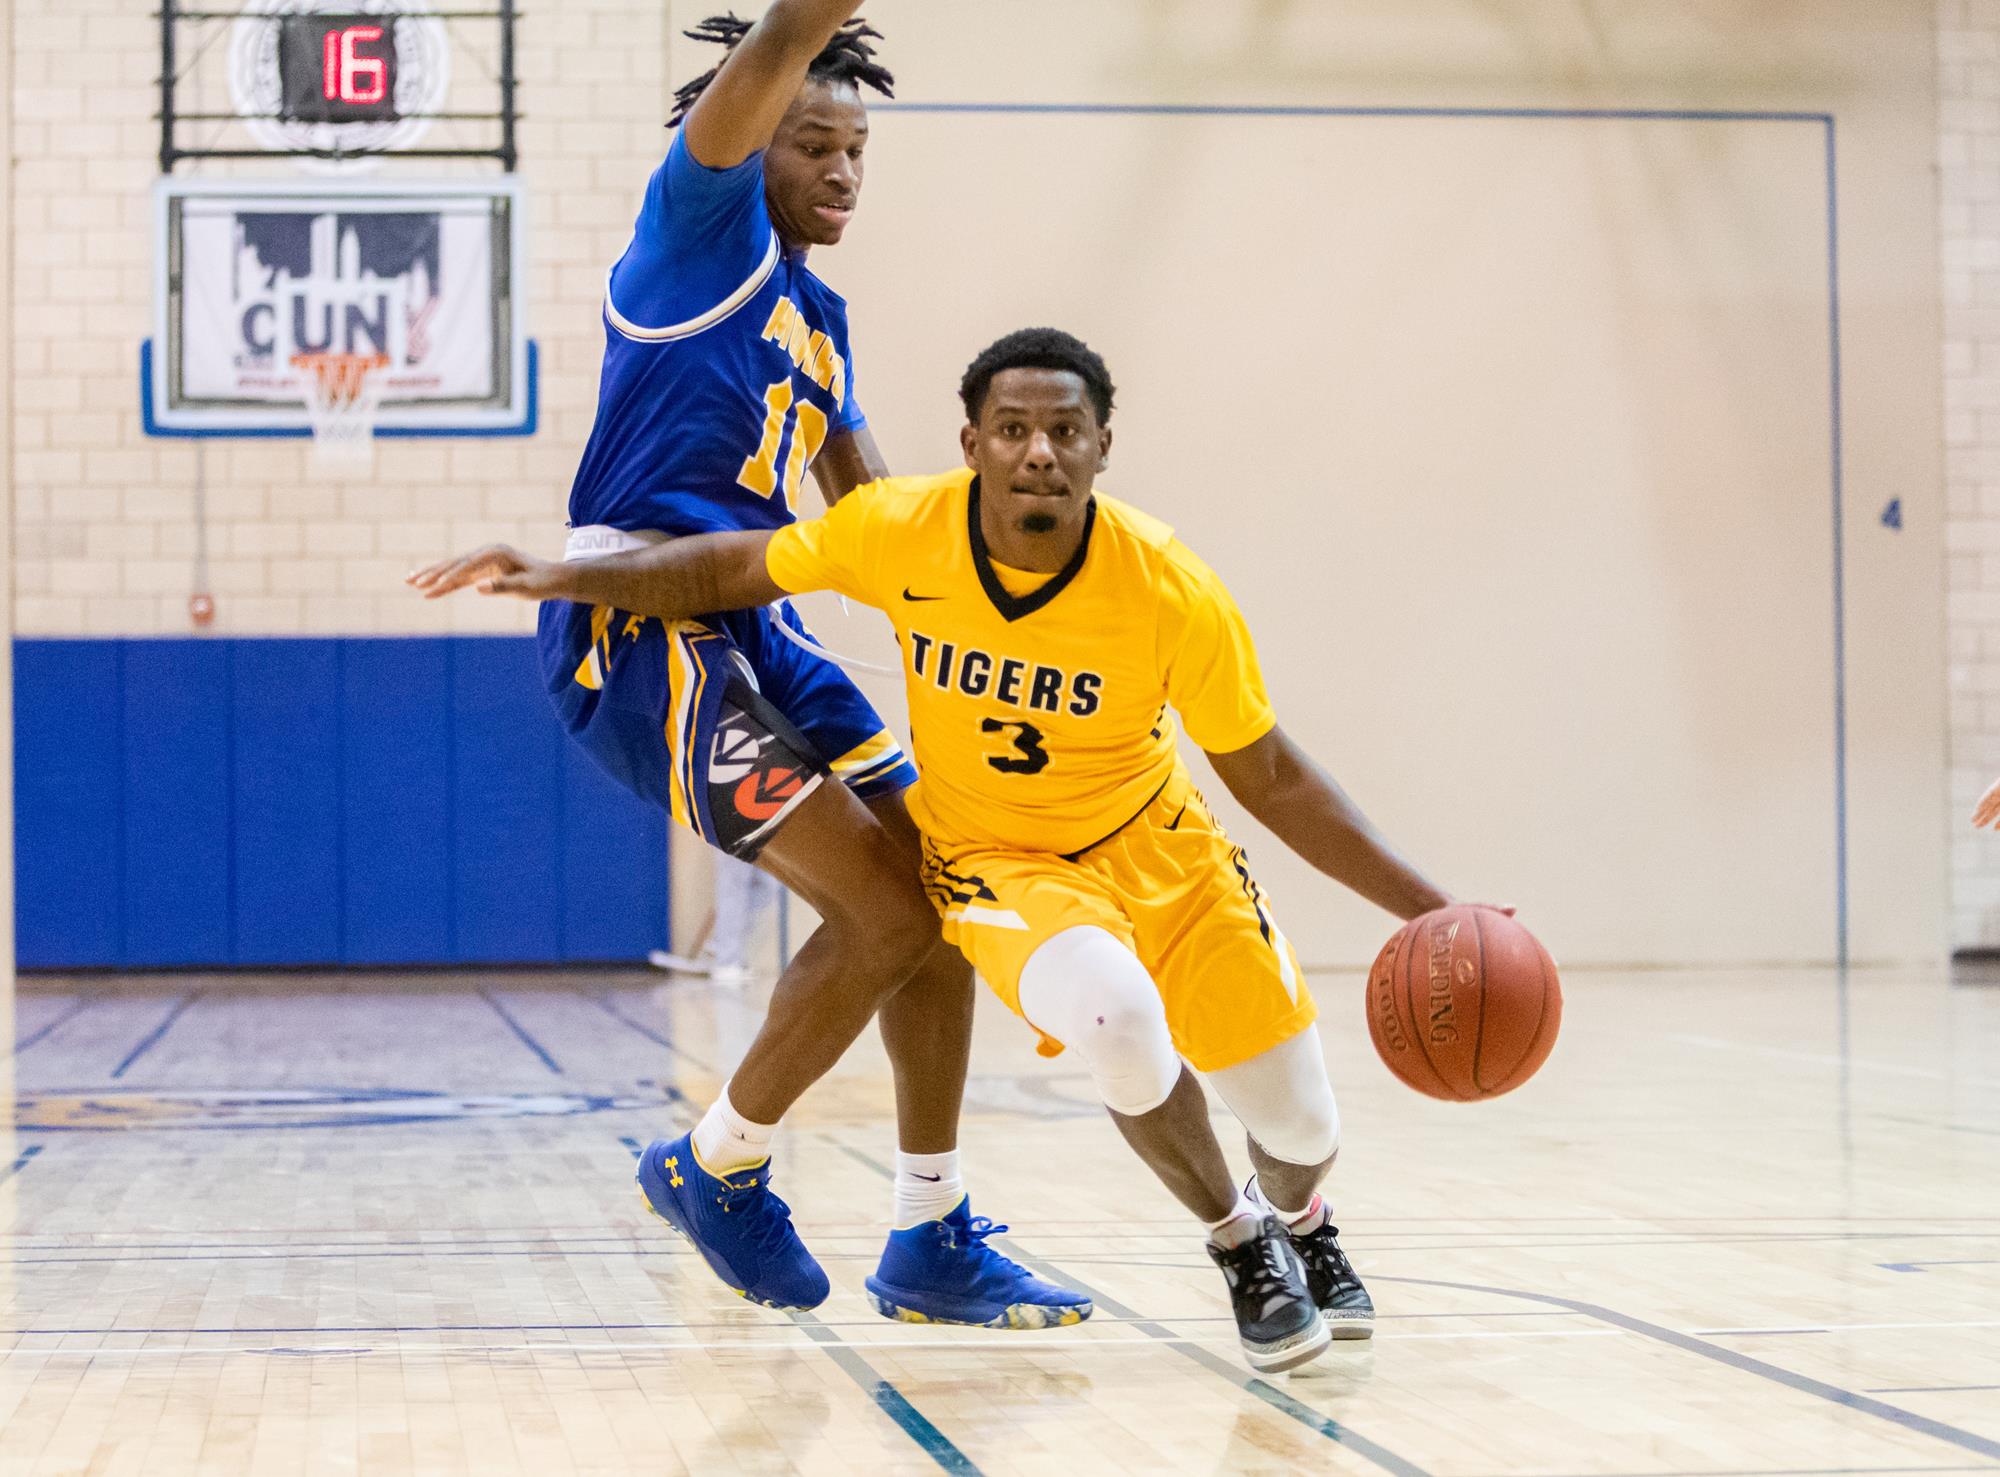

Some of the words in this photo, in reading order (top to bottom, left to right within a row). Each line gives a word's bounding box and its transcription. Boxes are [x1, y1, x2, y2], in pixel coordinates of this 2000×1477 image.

[323, 26, 387, 104] 16
[735, 375, 829, 519] 10
[909, 629, 1103, 718] TIGERS
[979, 716, 1051, 776] 3
